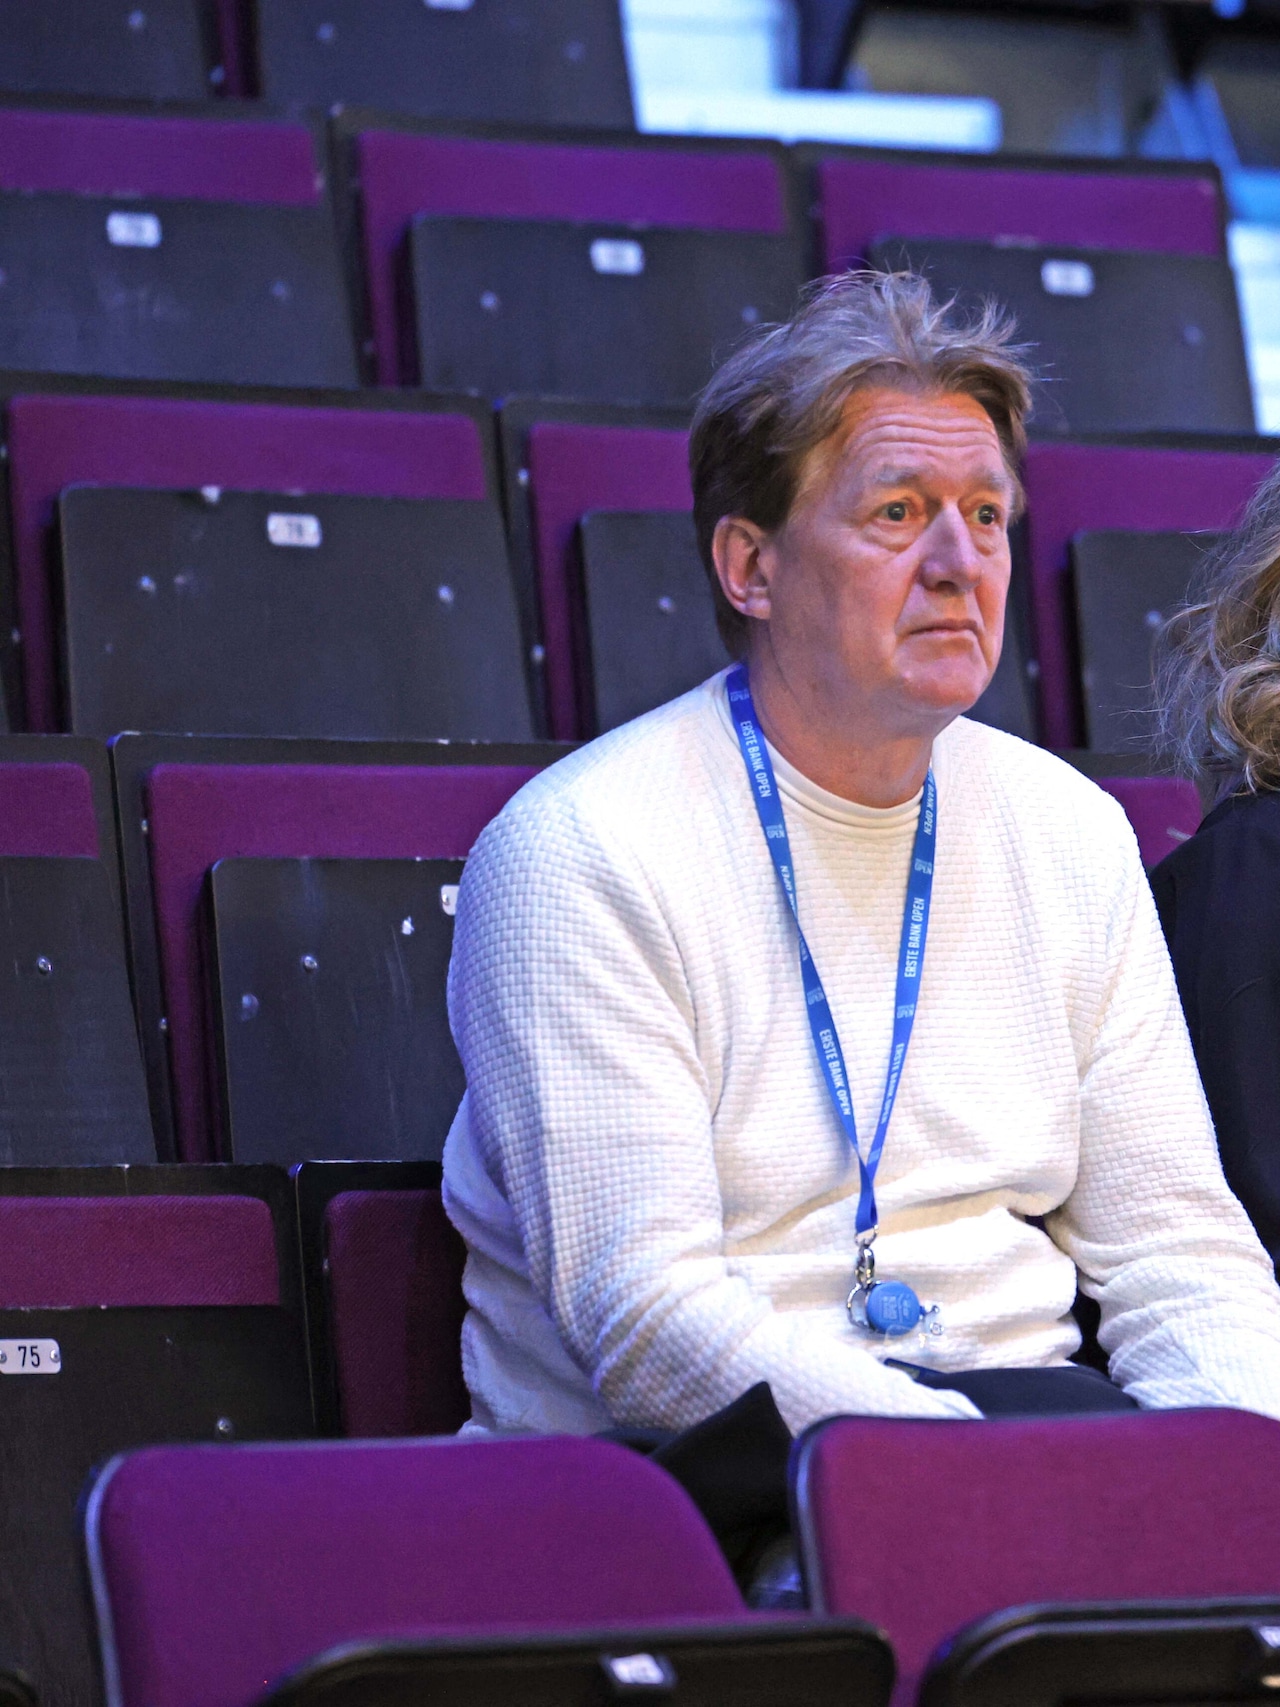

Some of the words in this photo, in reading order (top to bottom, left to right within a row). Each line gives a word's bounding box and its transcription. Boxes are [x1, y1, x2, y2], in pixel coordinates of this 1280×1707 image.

[740, 720, 758, 746] ERSTE
[747, 745, 766, 772] BANK
[755, 772, 772, 798] OPEN
[924, 810, 934, 836] OPEN
[911, 897, 925, 922] OPEN
[908, 923, 922, 949] BANK
[904, 950, 919, 978] ERSTE
[819, 1028, 838, 1060] ERSTE
[828, 1060, 846, 1088] BANK
[836, 1089, 852, 1116] OPEN
[17, 1344, 41, 1369] 75
